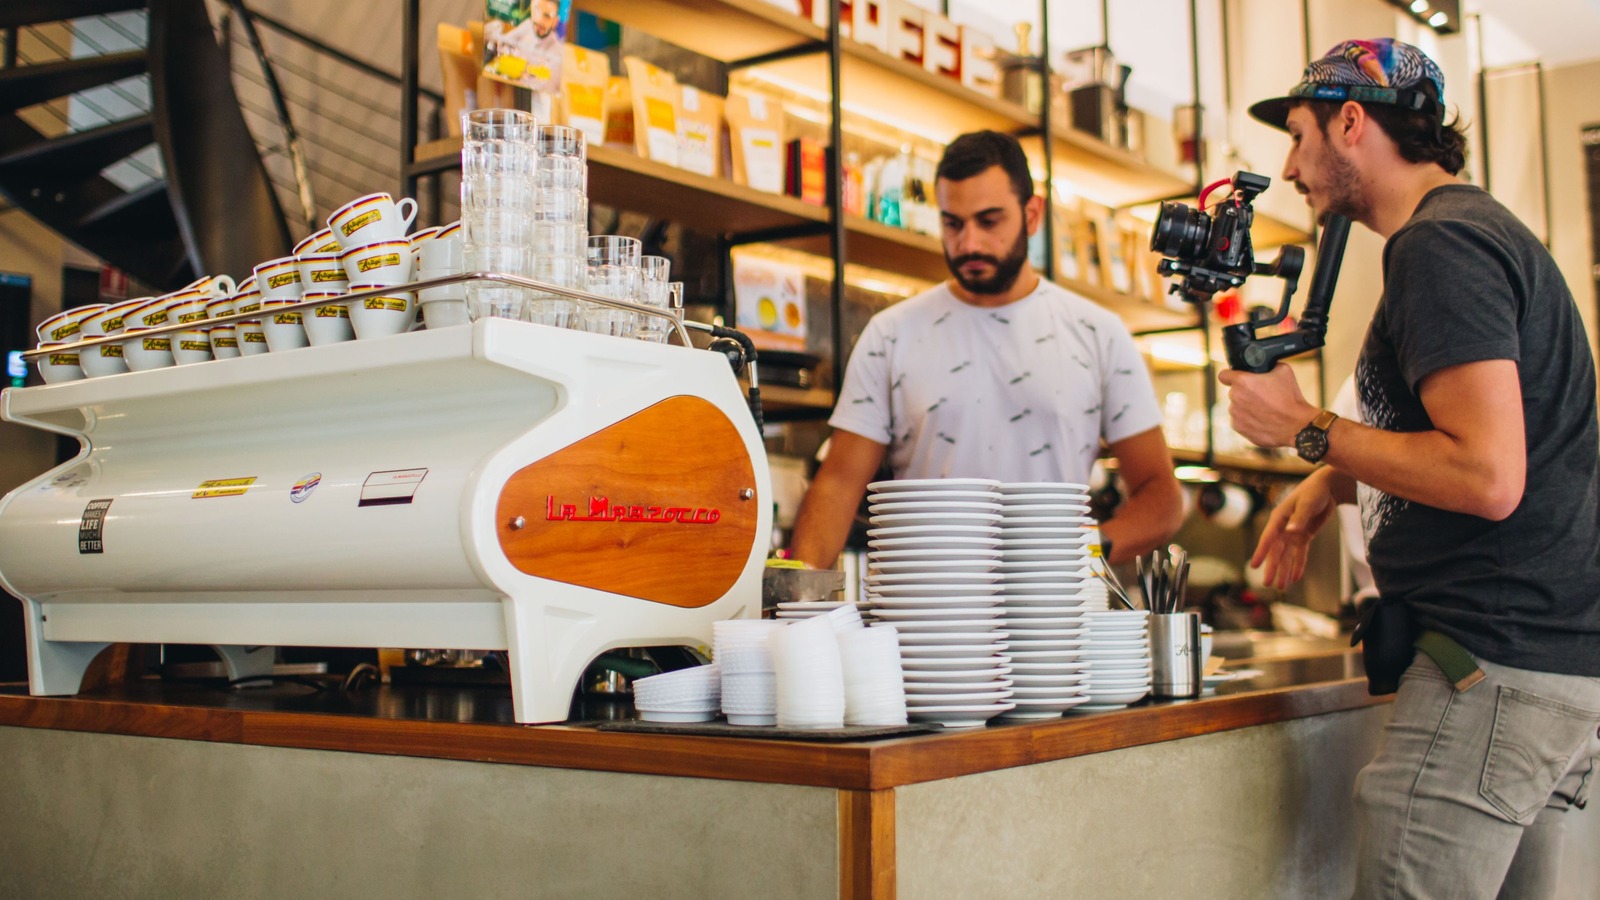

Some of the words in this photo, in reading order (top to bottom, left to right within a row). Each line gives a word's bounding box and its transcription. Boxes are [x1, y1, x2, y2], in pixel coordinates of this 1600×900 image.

[87, 502, 110, 510] COFFEE
[84, 510, 102, 518] MAKES
[81, 519, 98, 530] LIFE
[80, 540, 102, 550] BETTER
